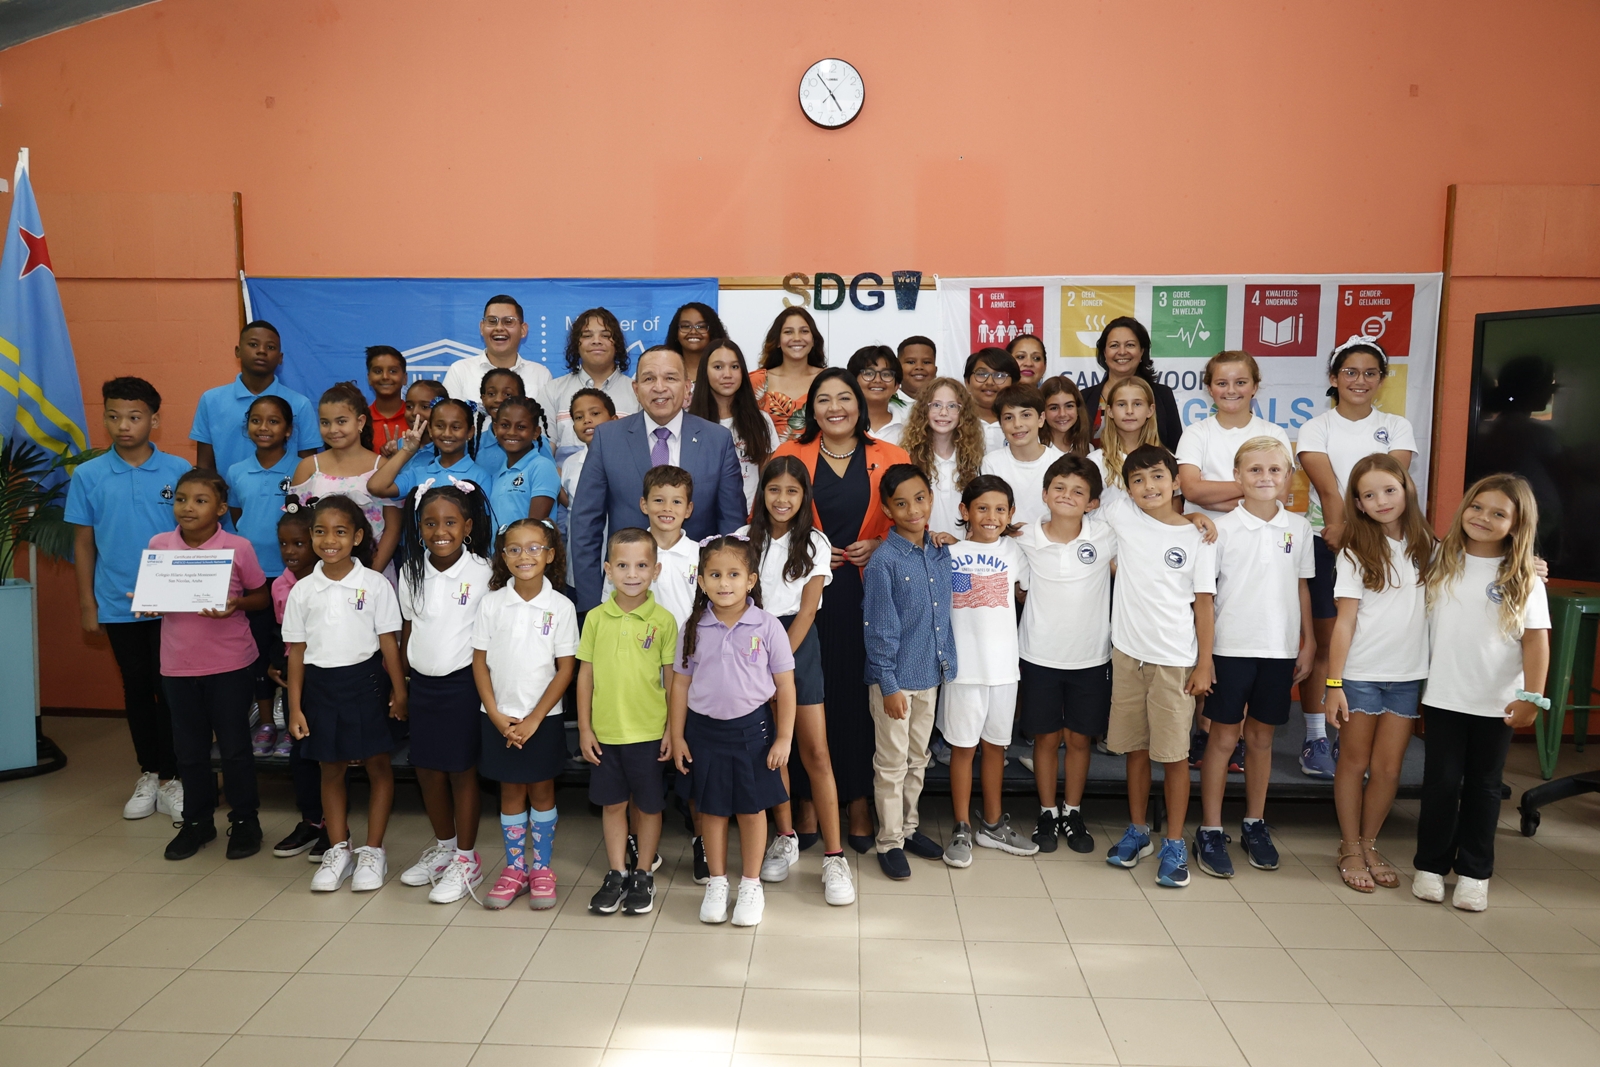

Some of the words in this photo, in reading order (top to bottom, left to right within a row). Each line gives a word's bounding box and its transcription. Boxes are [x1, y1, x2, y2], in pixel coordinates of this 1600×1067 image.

[782, 272, 885, 311] SDG
[1067, 291, 1076, 307] 2
[1159, 291, 1168, 307] 3
[1251, 290, 1260, 306] 4
[1344, 290, 1353, 306] 5
[978, 293, 984, 309] 1
[990, 301, 1016, 309] ARMOEDE
[1081, 299, 1103, 307] HONGER
[1172, 299, 1206, 307] GEZONDHEID
[1265, 298, 1298, 306] ONDERWIJS
[1359, 298, 1391, 306] GELIJKHEID
[1180, 307, 1203, 315] WELZIJN
[642, 316, 660, 331] of
[951, 554, 973, 570] OLD
[977, 553, 1008, 572] NAVY
